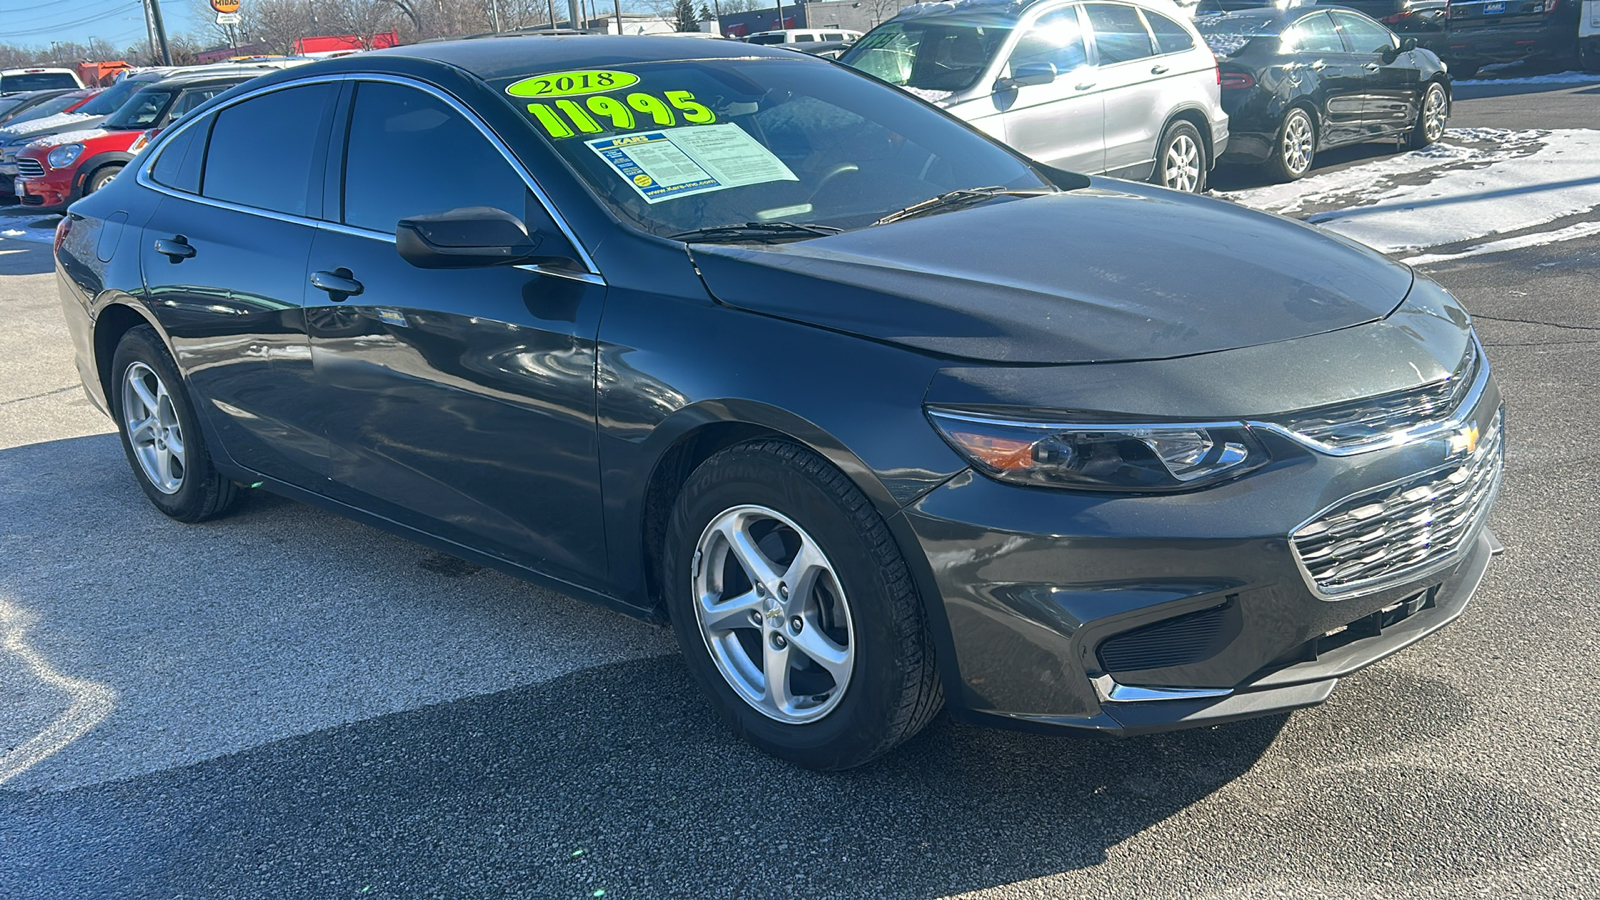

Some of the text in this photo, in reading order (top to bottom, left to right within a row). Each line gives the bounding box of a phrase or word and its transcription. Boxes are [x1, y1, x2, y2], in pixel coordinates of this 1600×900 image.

[534, 72, 615, 95] 2018
[527, 90, 716, 138] 11995
[612, 135, 649, 146] KARS
